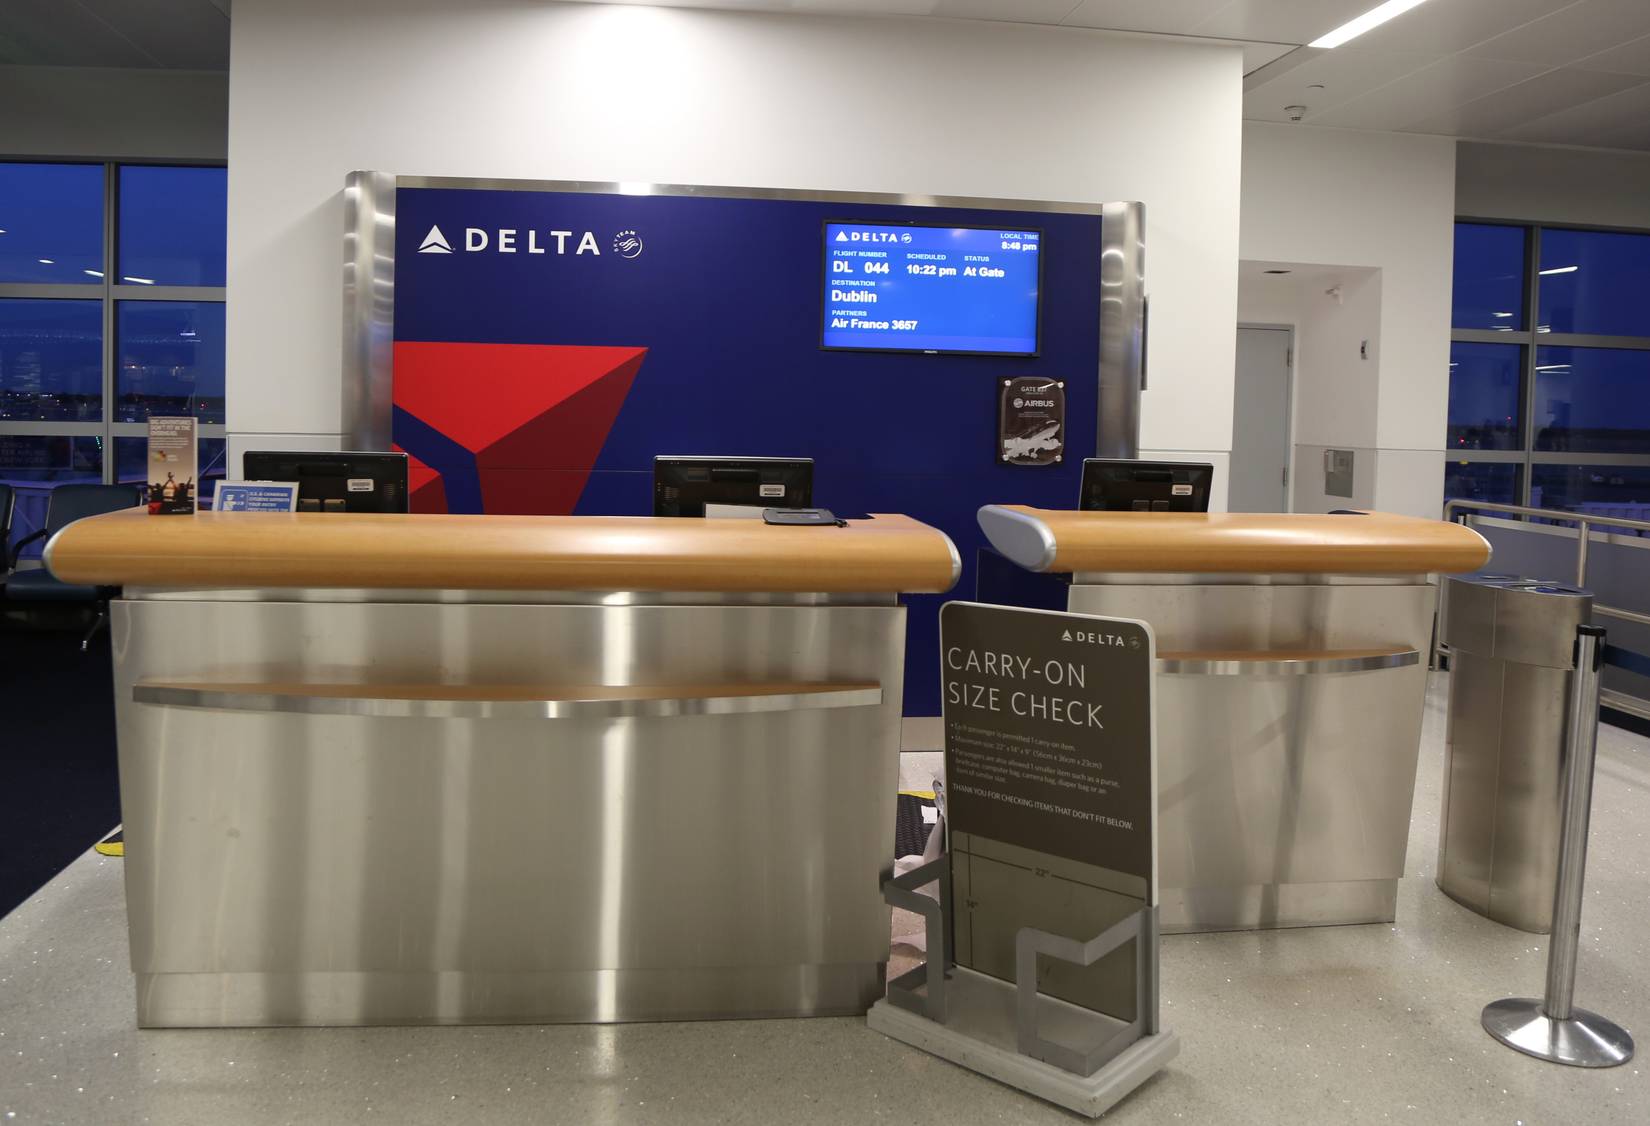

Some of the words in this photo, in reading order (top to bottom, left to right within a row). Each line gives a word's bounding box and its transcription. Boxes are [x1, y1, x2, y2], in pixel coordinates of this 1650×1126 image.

[466, 228, 600, 256] DELTA
[851, 232, 898, 242] DELTA
[1022, 243, 1037, 251] pm
[833, 261, 853, 272] DL
[864, 262, 890, 274] 044
[906, 265, 936, 274] 10:22
[939, 267, 956, 277] pm
[964, 267, 976, 276] At
[979, 268, 1004, 277] Gate
[832, 290, 877, 303] Dublin
[831, 318, 848, 328] Air
[851, 319, 889, 329] France
[892, 320, 917, 330] 3657
[1076, 632, 1125, 647] DELTA
[948, 647, 1086, 688] CARRY-ON
[948, 682, 1000, 712] SIZE
[1011, 692, 1104, 729] CHECK
[1002, 732, 1031, 742] permitted
[1034, 765, 1056, 774] smaller
[1081, 759, 1102, 770] 23cm)
[952, 783, 973, 794] THANK
[973, 788, 987, 797] YOU
[988, 790, 1000, 800] FOR
[1001, 794, 1033, 807] CHECKING
[1034, 801, 1054, 812] ITEMS
[1054, 805, 1071, 816] THAT
[1072, 809, 1095, 821] DON'T
[1095, 815, 1106, 824] FIT
[1106, 817, 1133, 830] BELOW.
[1035, 867, 1050, 878] 22"
